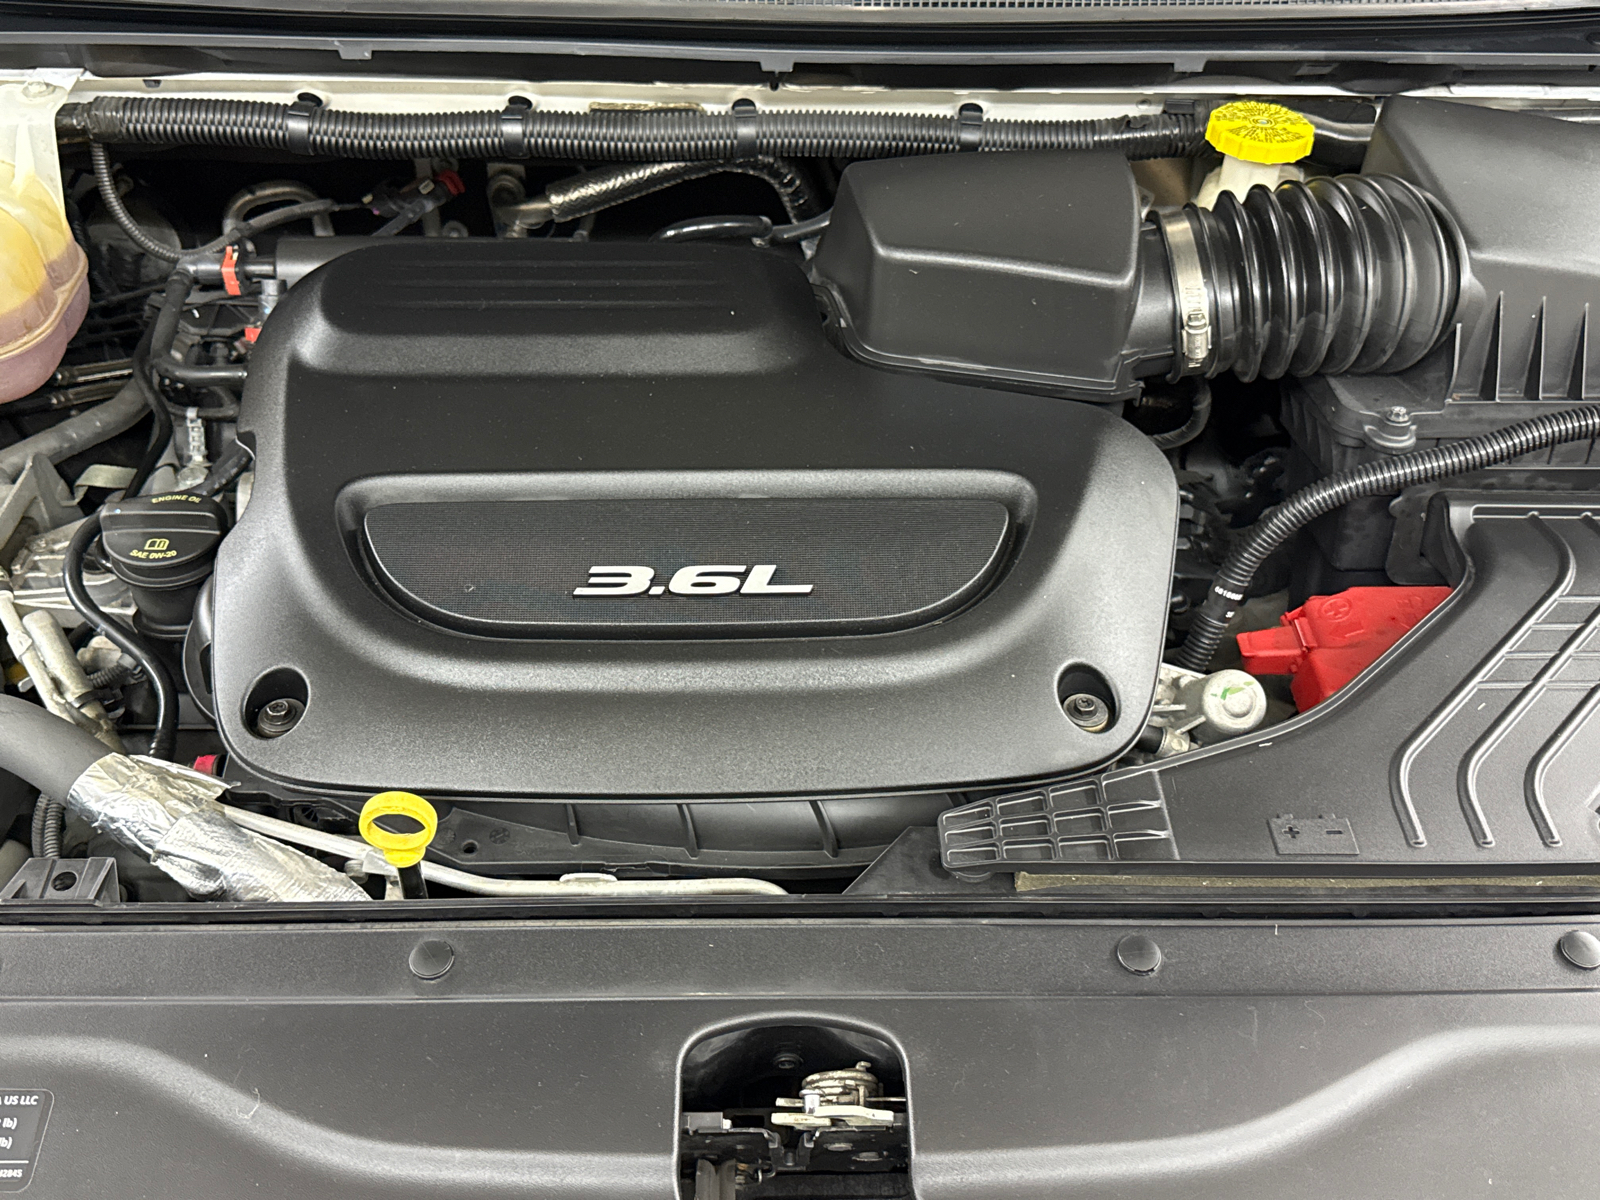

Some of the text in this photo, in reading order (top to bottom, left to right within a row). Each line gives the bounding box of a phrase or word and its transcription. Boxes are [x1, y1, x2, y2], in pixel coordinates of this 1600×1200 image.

[151, 495, 202, 504] ENGINE OIL
[129, 549, 177, 559] SAE 0W-20
[572, 565, 814, 596] 3.6L
[3, 1094, 19, 1106] US
[20, 1094, 39, 1106] LLC
[2, 1117, 18, 1130] lb)
